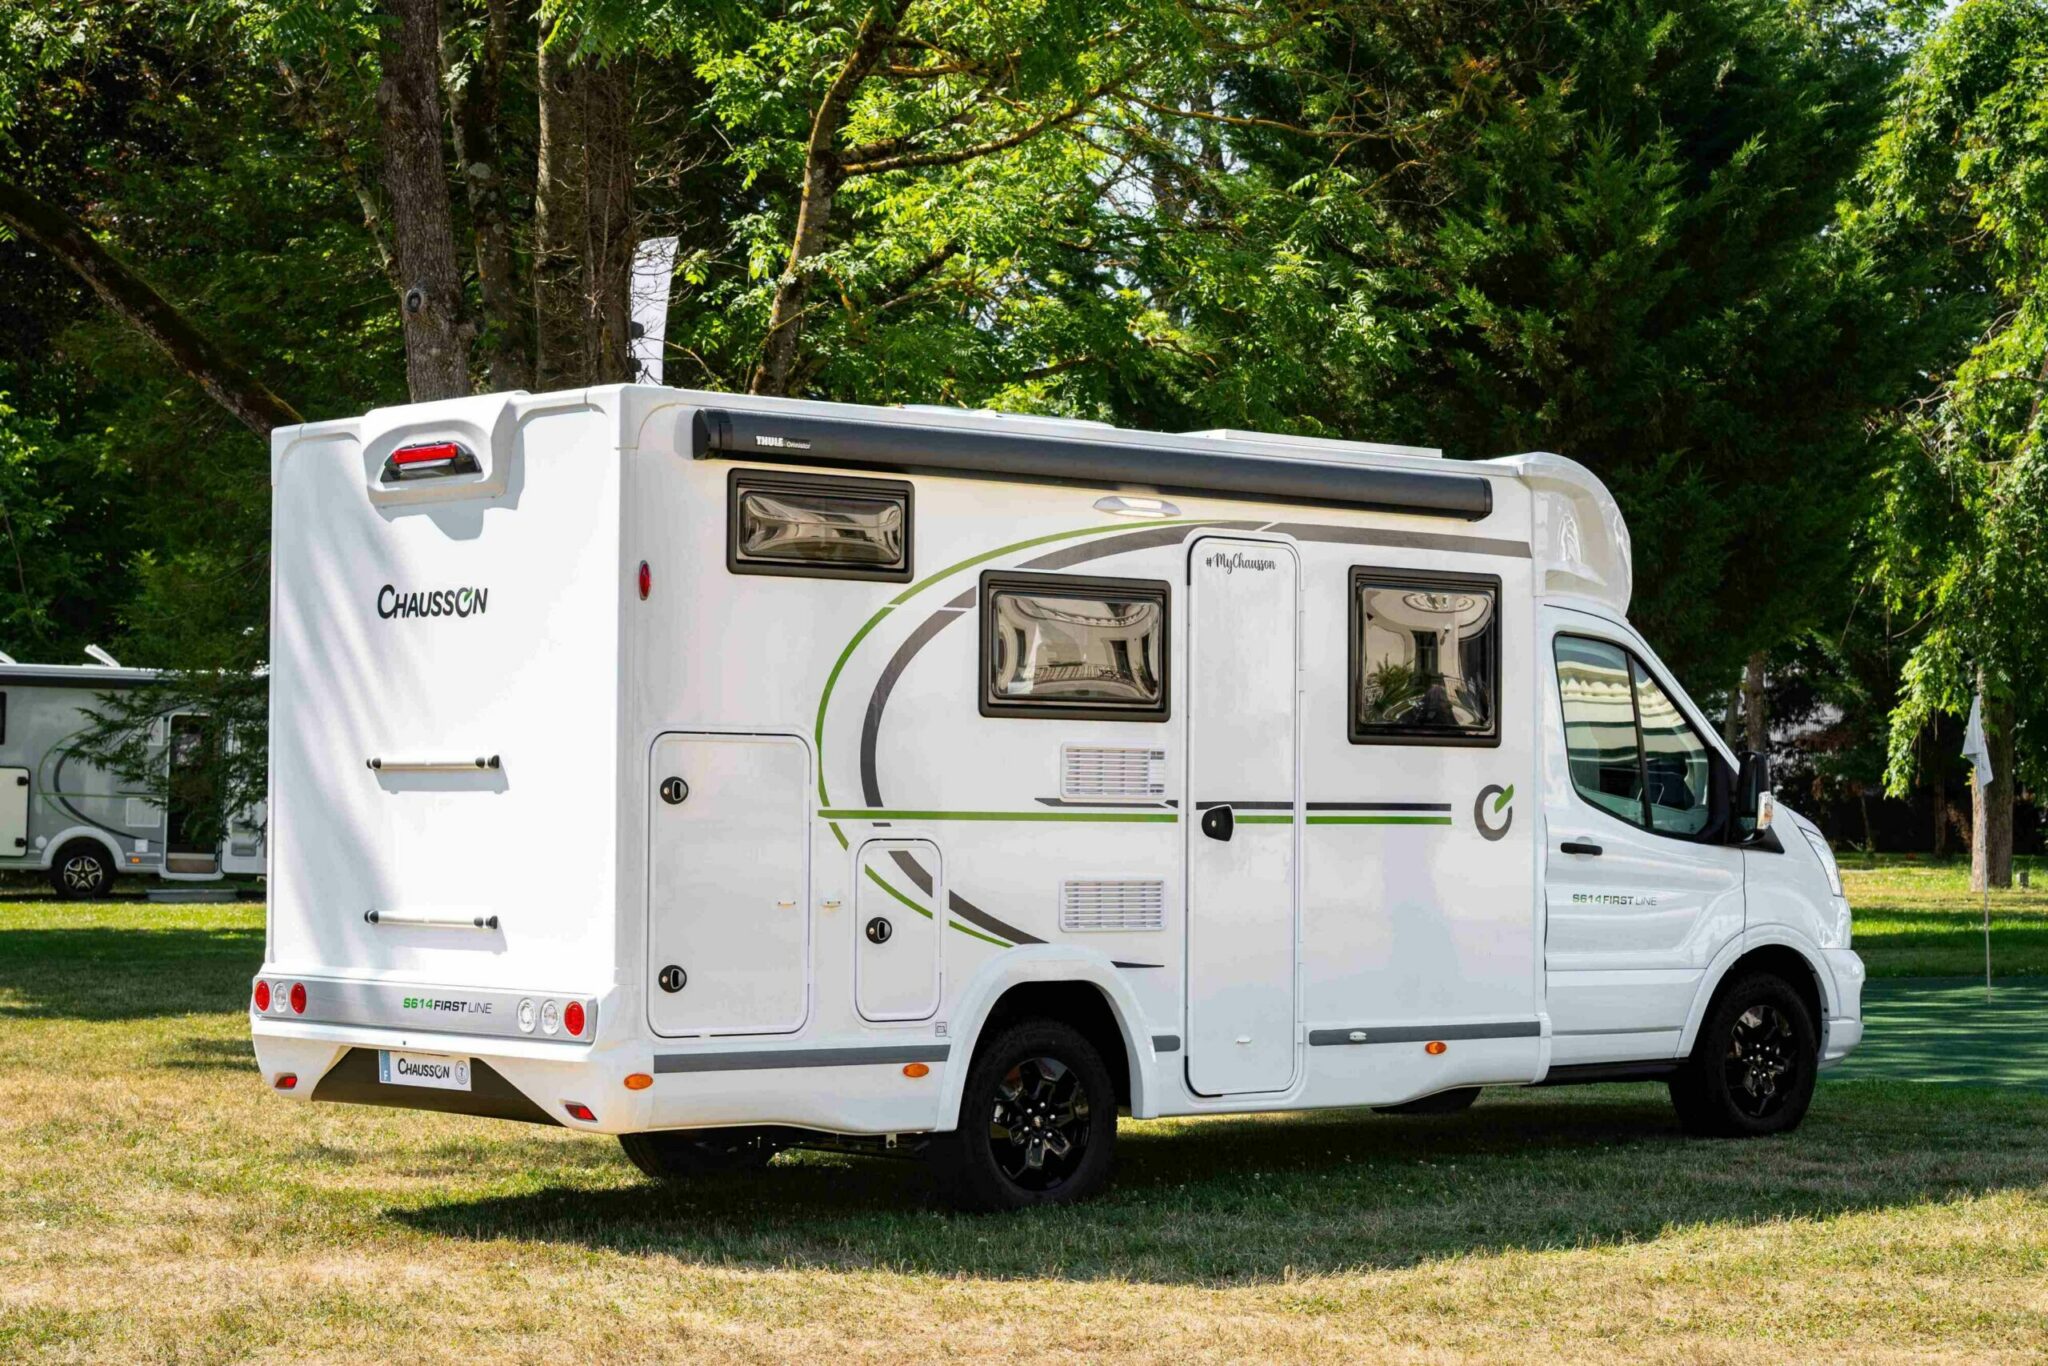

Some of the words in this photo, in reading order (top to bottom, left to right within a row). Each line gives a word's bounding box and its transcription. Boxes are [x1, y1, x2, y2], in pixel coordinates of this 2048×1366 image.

[755, 435, 783, 448] THULE
[1206, 552, 1276, 575] #MyChausson
[377, 584, 488, 619] CHAUSSON
[398, 1058, 450, 1079] CHAUSSON
